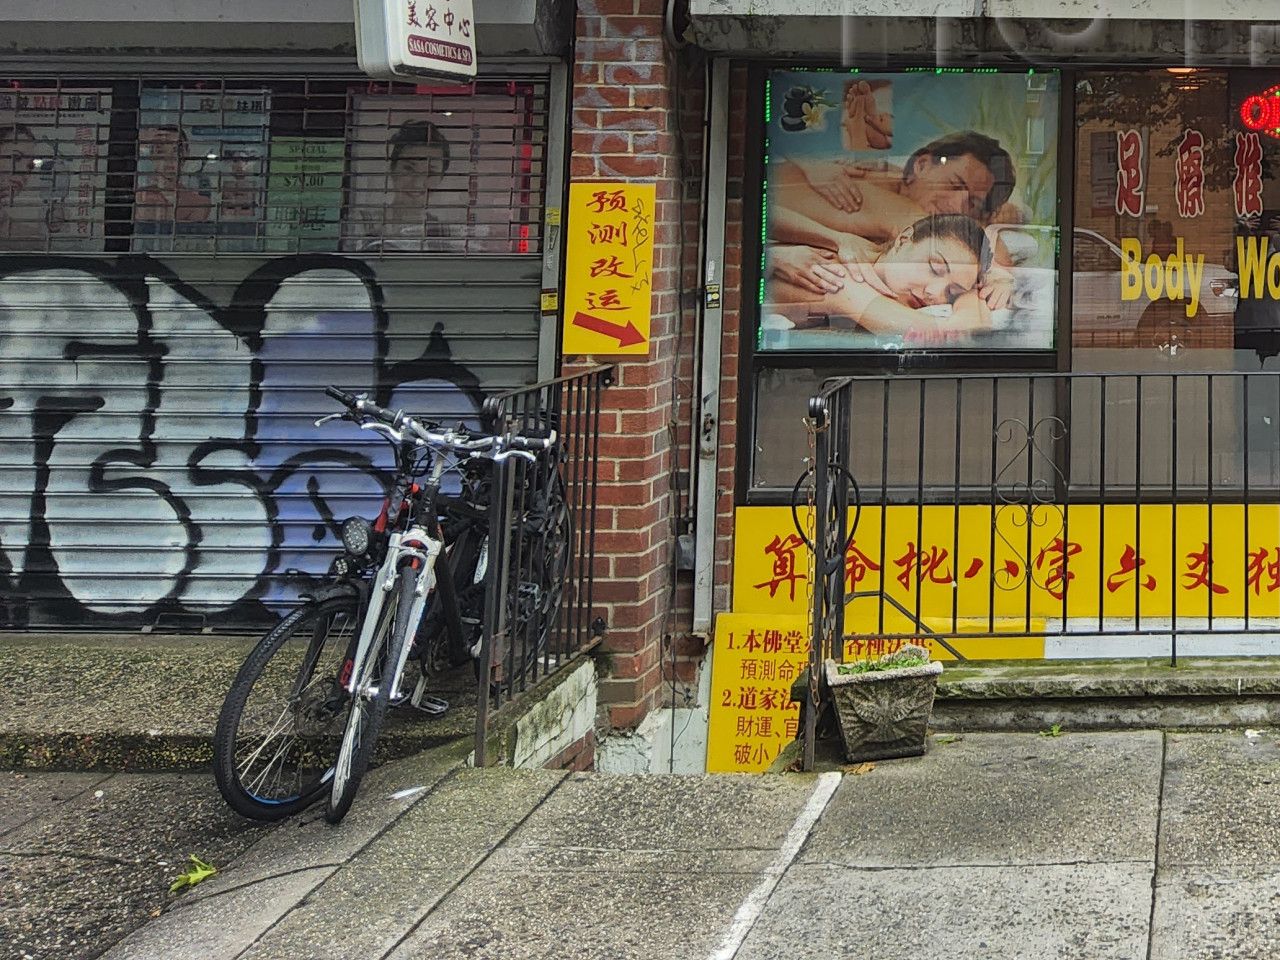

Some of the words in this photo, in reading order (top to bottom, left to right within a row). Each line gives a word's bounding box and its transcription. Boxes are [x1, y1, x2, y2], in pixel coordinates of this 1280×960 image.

[406, 0, 471, 38] 美容中心
[585, 189, 635, 311] 预测改运
[1120, 235, 1205, 319] Body
